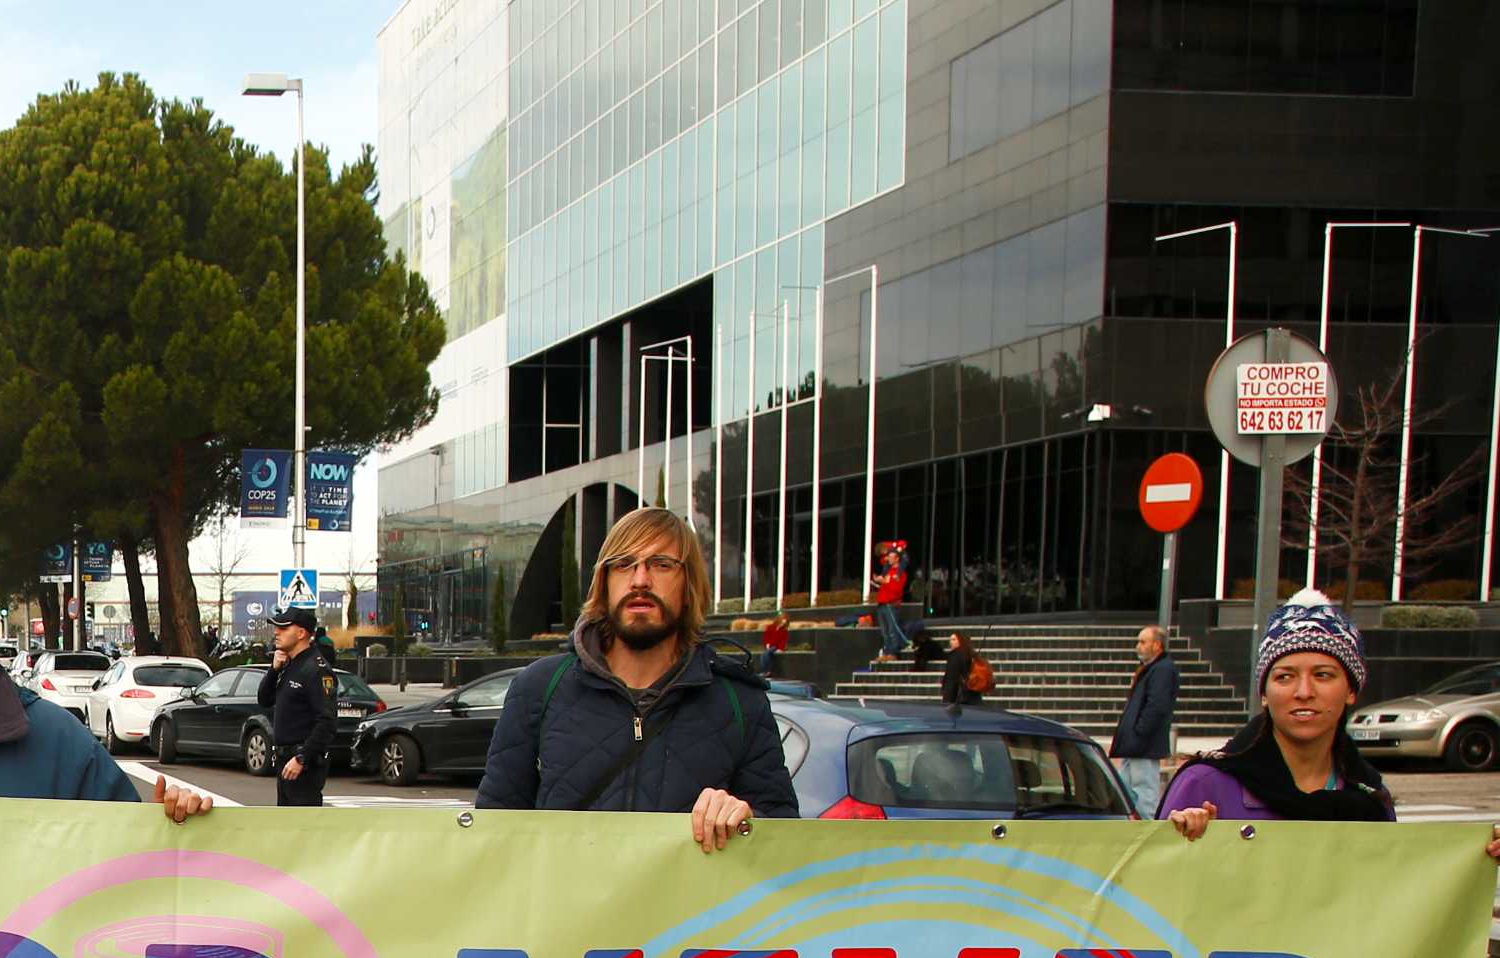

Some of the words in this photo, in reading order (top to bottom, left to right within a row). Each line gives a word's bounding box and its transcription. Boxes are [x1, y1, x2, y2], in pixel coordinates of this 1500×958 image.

[1247, 366, 1320, 380] COMPRO
[1241, 383, 1261, 395] TU
[1266, 382, 1324, 396] COCHE
[1240, 399, 1251, 407] NO
[1251, 399, 1283, 407] IMPORTA
[1284, 399, 1313, 407] ESTADO
[1240, 411, 1264, 430] 642
[1268, 410, 1284, 430] 63
[1287, 410, 1304, 430] 62
[1308, 410, 1323, 430] 17
[310, 463, 349, 481] NOW
[248, 490, 276, 500] COP25
